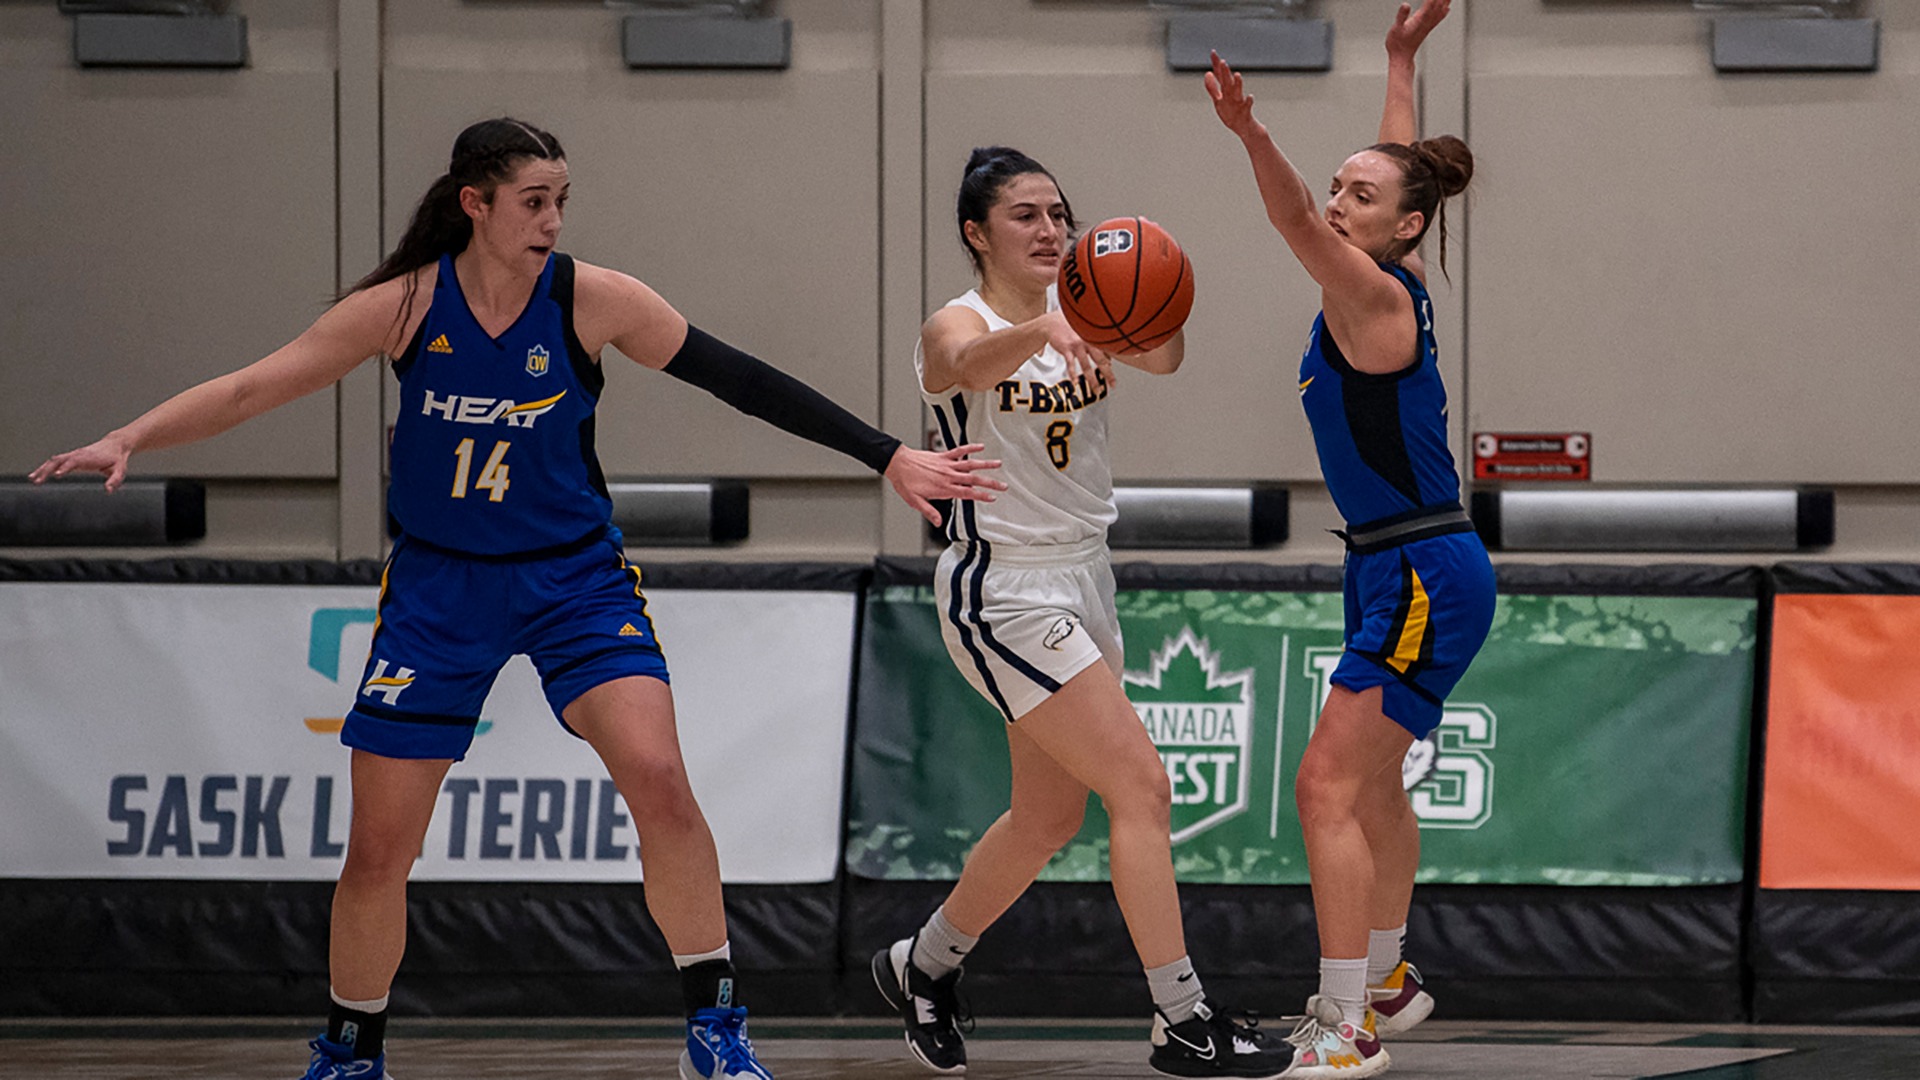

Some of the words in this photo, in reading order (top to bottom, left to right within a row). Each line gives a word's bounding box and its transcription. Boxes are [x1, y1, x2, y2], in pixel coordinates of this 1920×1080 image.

[422, 389, 567, 428] HEAT
[451, 438, 511, 502] 14
[1046, 420, 1073, 471] 8
[1134, 707, 1236, 741] ANADA
[1158, 753, 1236, 804] EST
[107, 775, 290, 857] SASK
[310, 777, 640, 860] LTERIE
